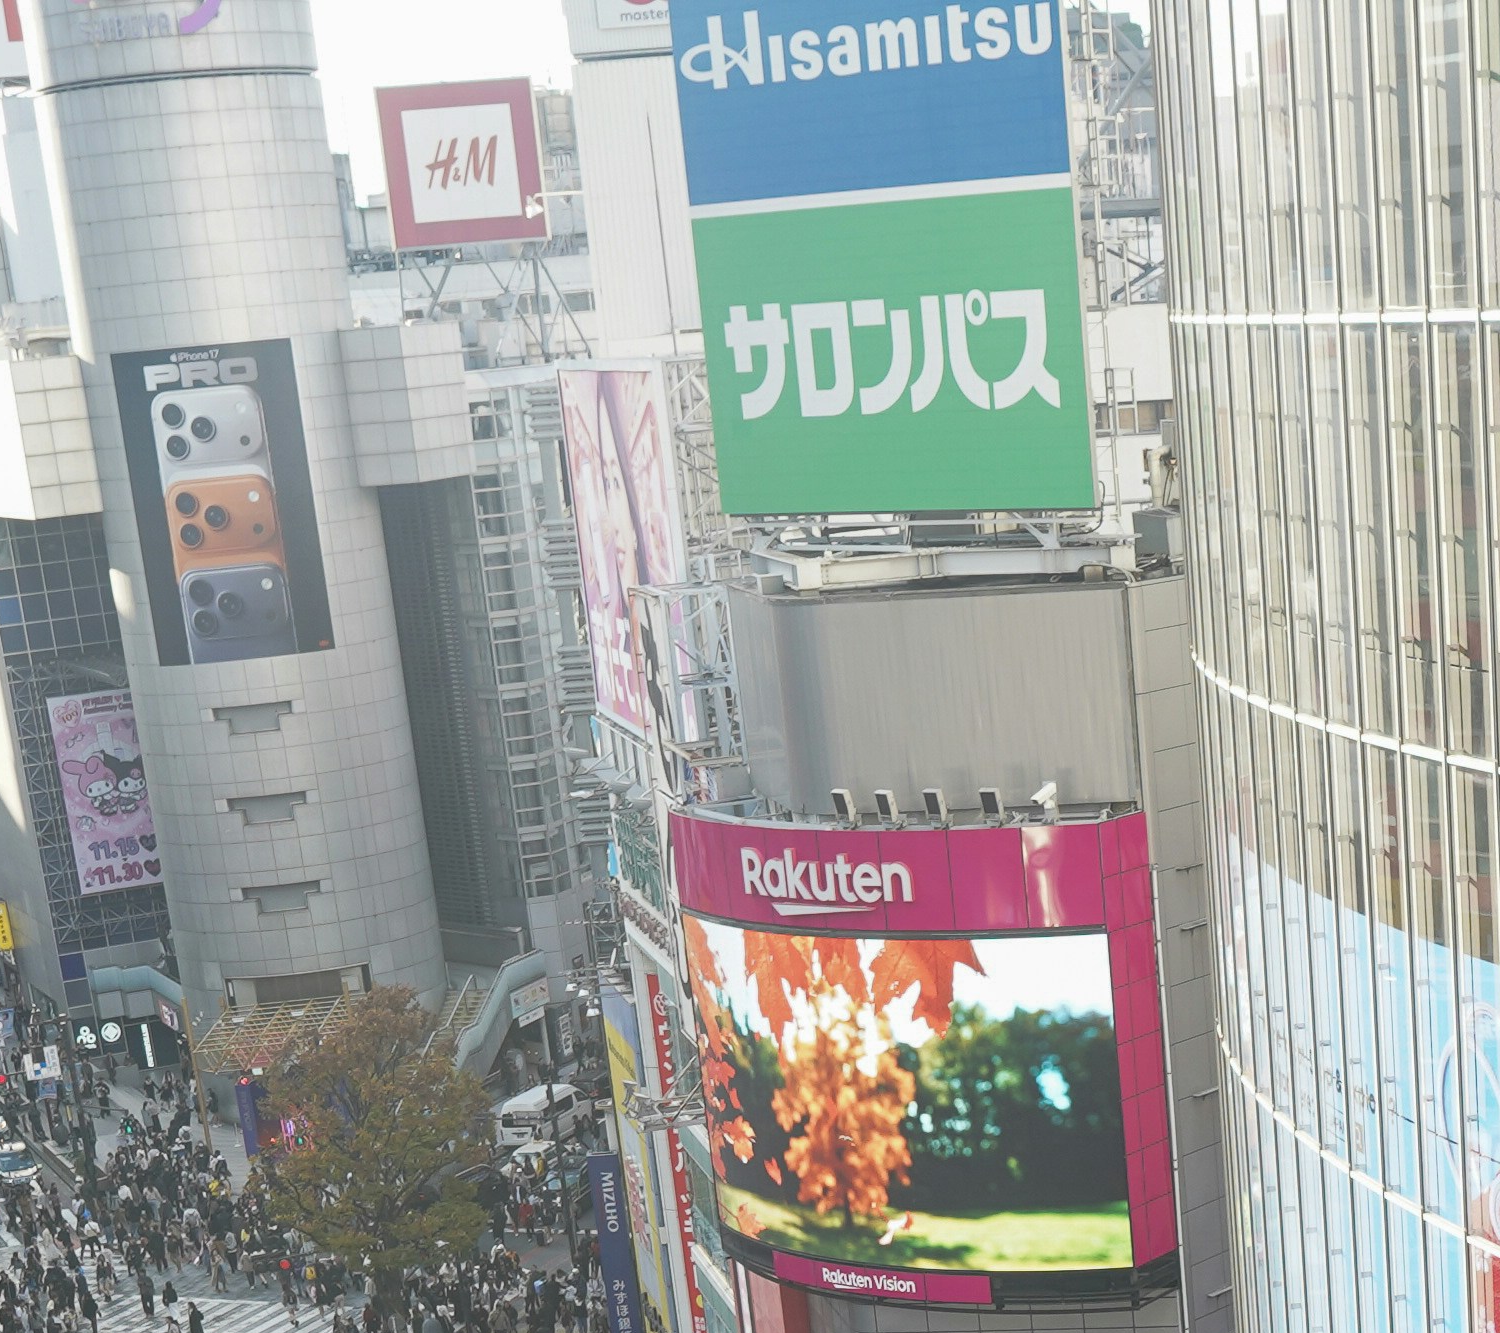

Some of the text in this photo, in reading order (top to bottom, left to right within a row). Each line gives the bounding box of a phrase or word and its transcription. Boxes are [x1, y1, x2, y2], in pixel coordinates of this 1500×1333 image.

[680, 3, 1053, 89] Hisamitsu
[425, 133, 498, 189] H&M
[142, 357, 258, 391] PRO
[177, 349, 219, 361] iPhone 17
[724, 287, 1061, 420] サロンパス
[88, 837, 140, 861] 11.15
[741, 847, 914, 905] Rakuten
[601, 1171, 621, 1233] MIZUHO
[822, 1266, 917, 1295] Rakuten Vision
